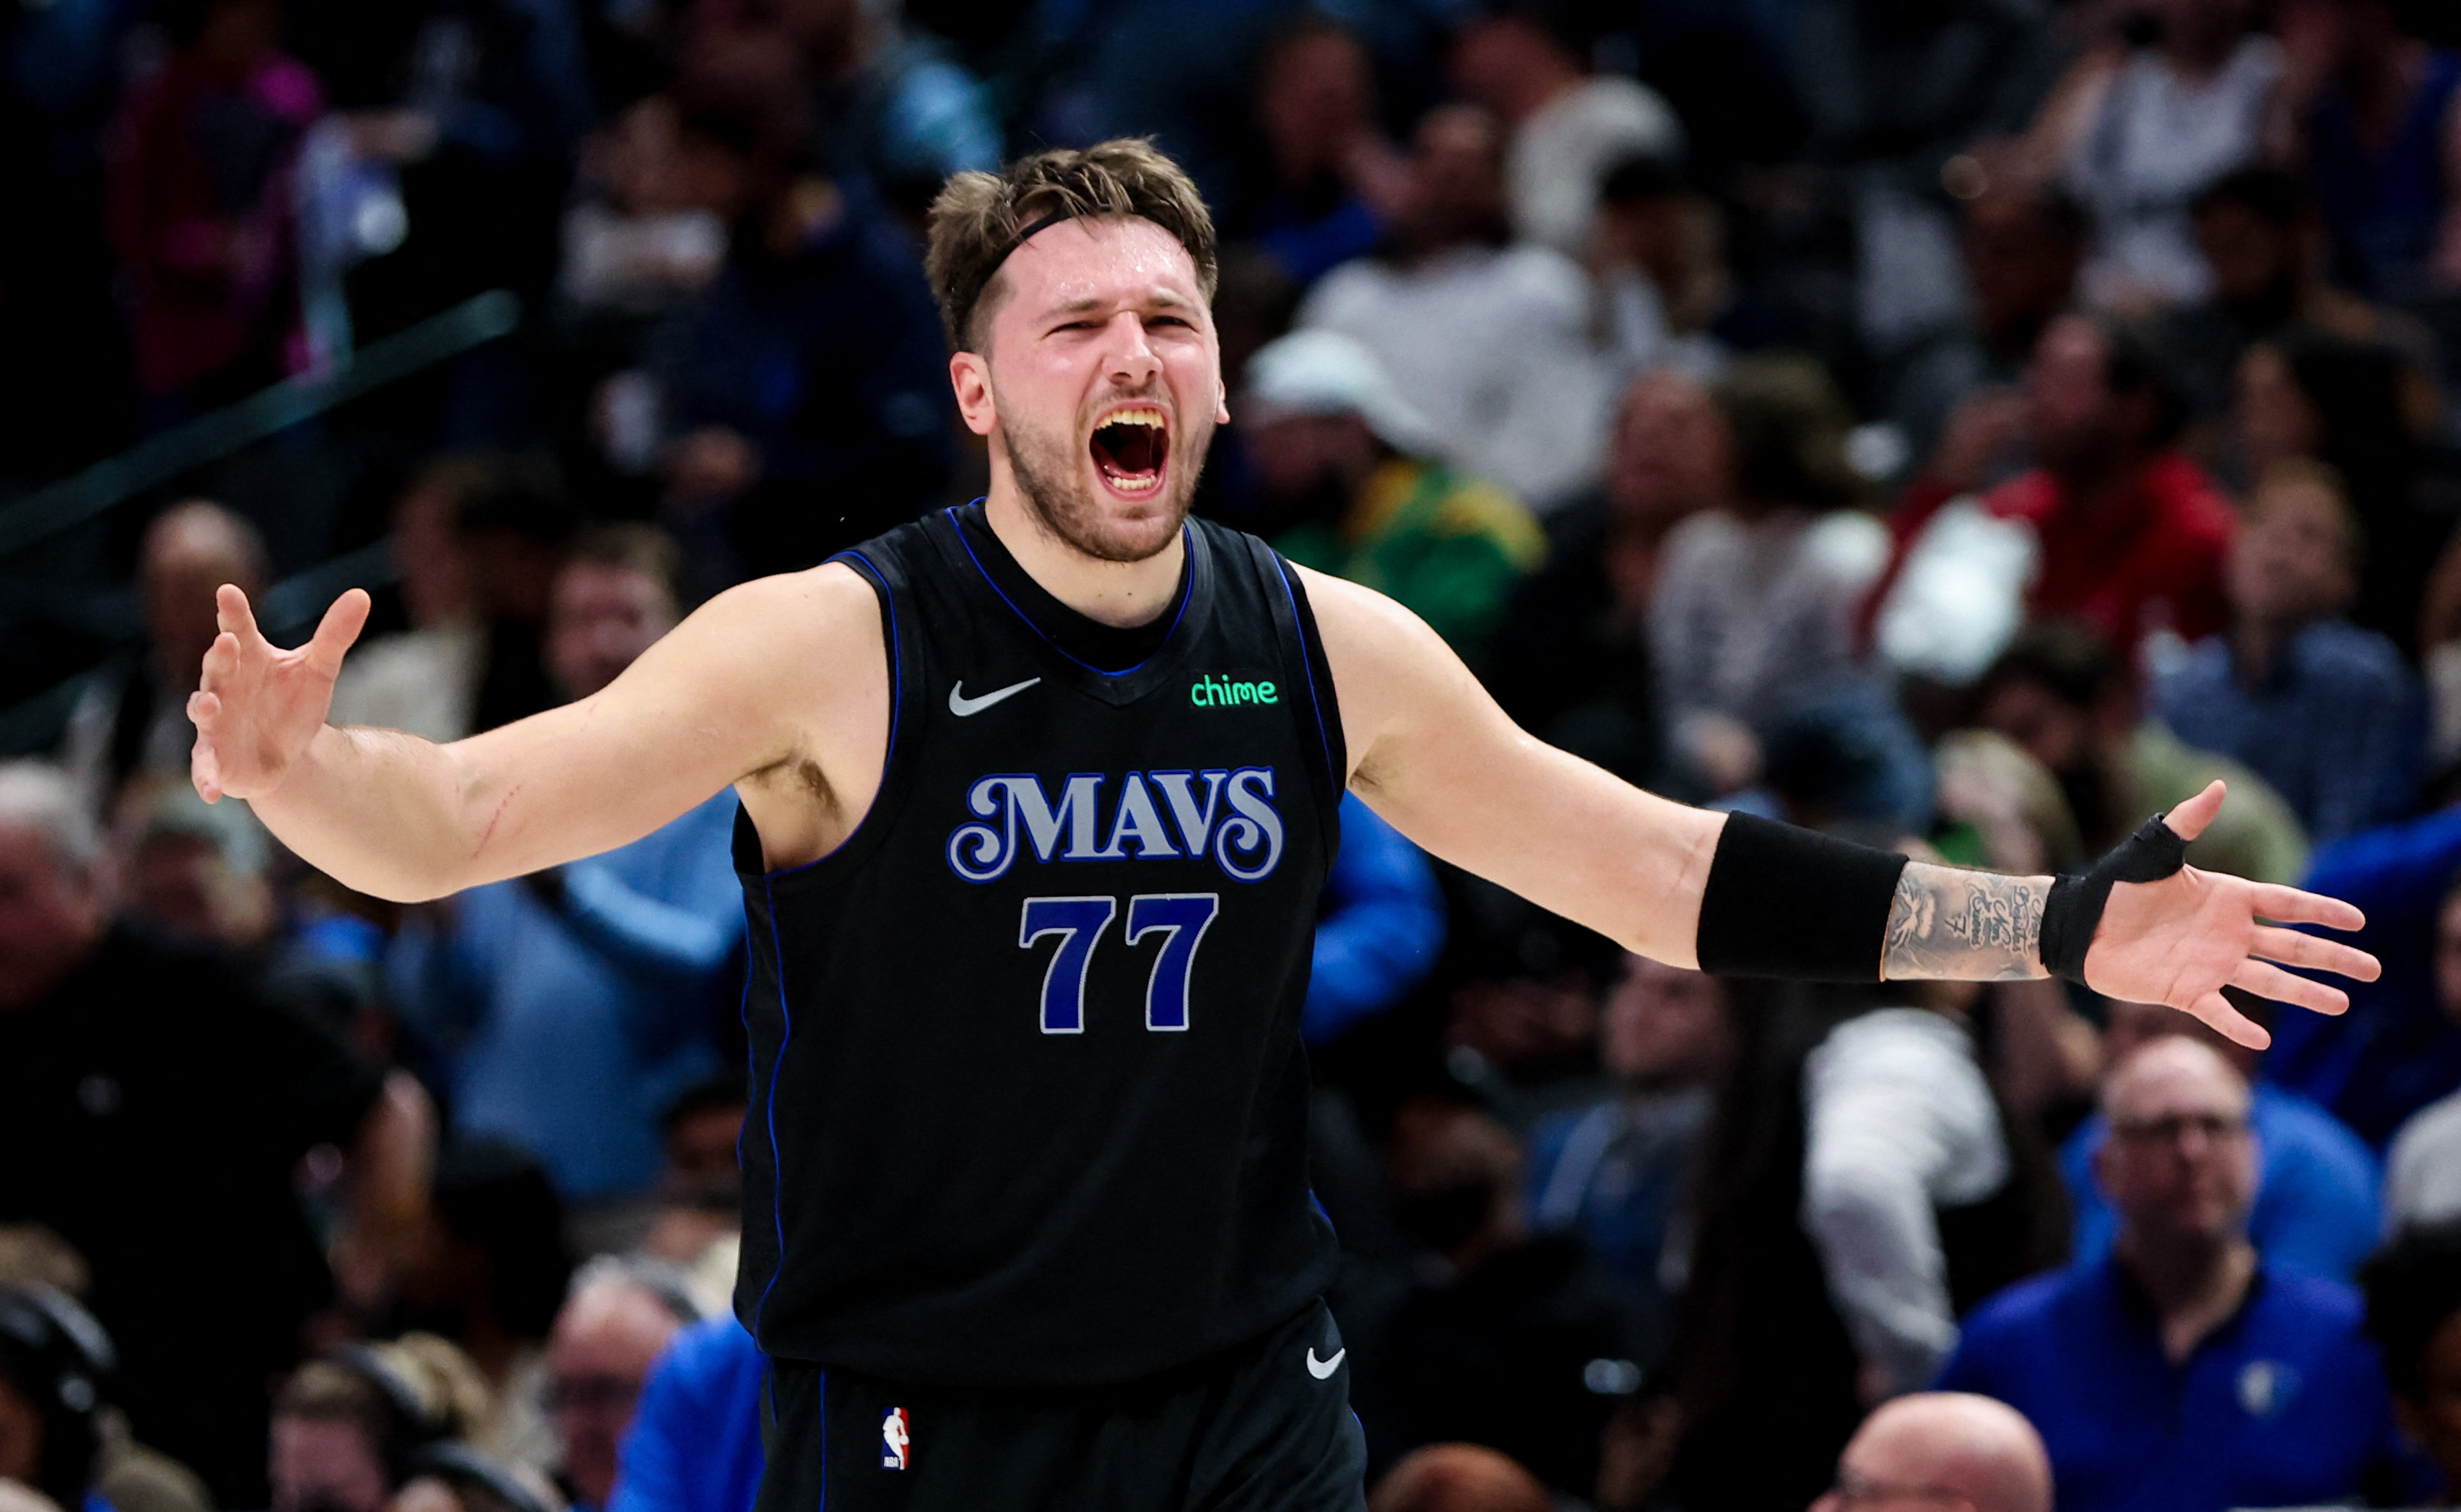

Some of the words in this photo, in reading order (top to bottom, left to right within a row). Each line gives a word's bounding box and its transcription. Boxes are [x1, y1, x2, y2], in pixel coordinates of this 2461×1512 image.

[1191, 674, 1278, 707] chime
[946, 766, 1284, 883] MAVS
[1944, 915, 1966, 934] 7
[1019, 893, 1218, 1033] 77
[884, 1456, 898, 1467] NBA
